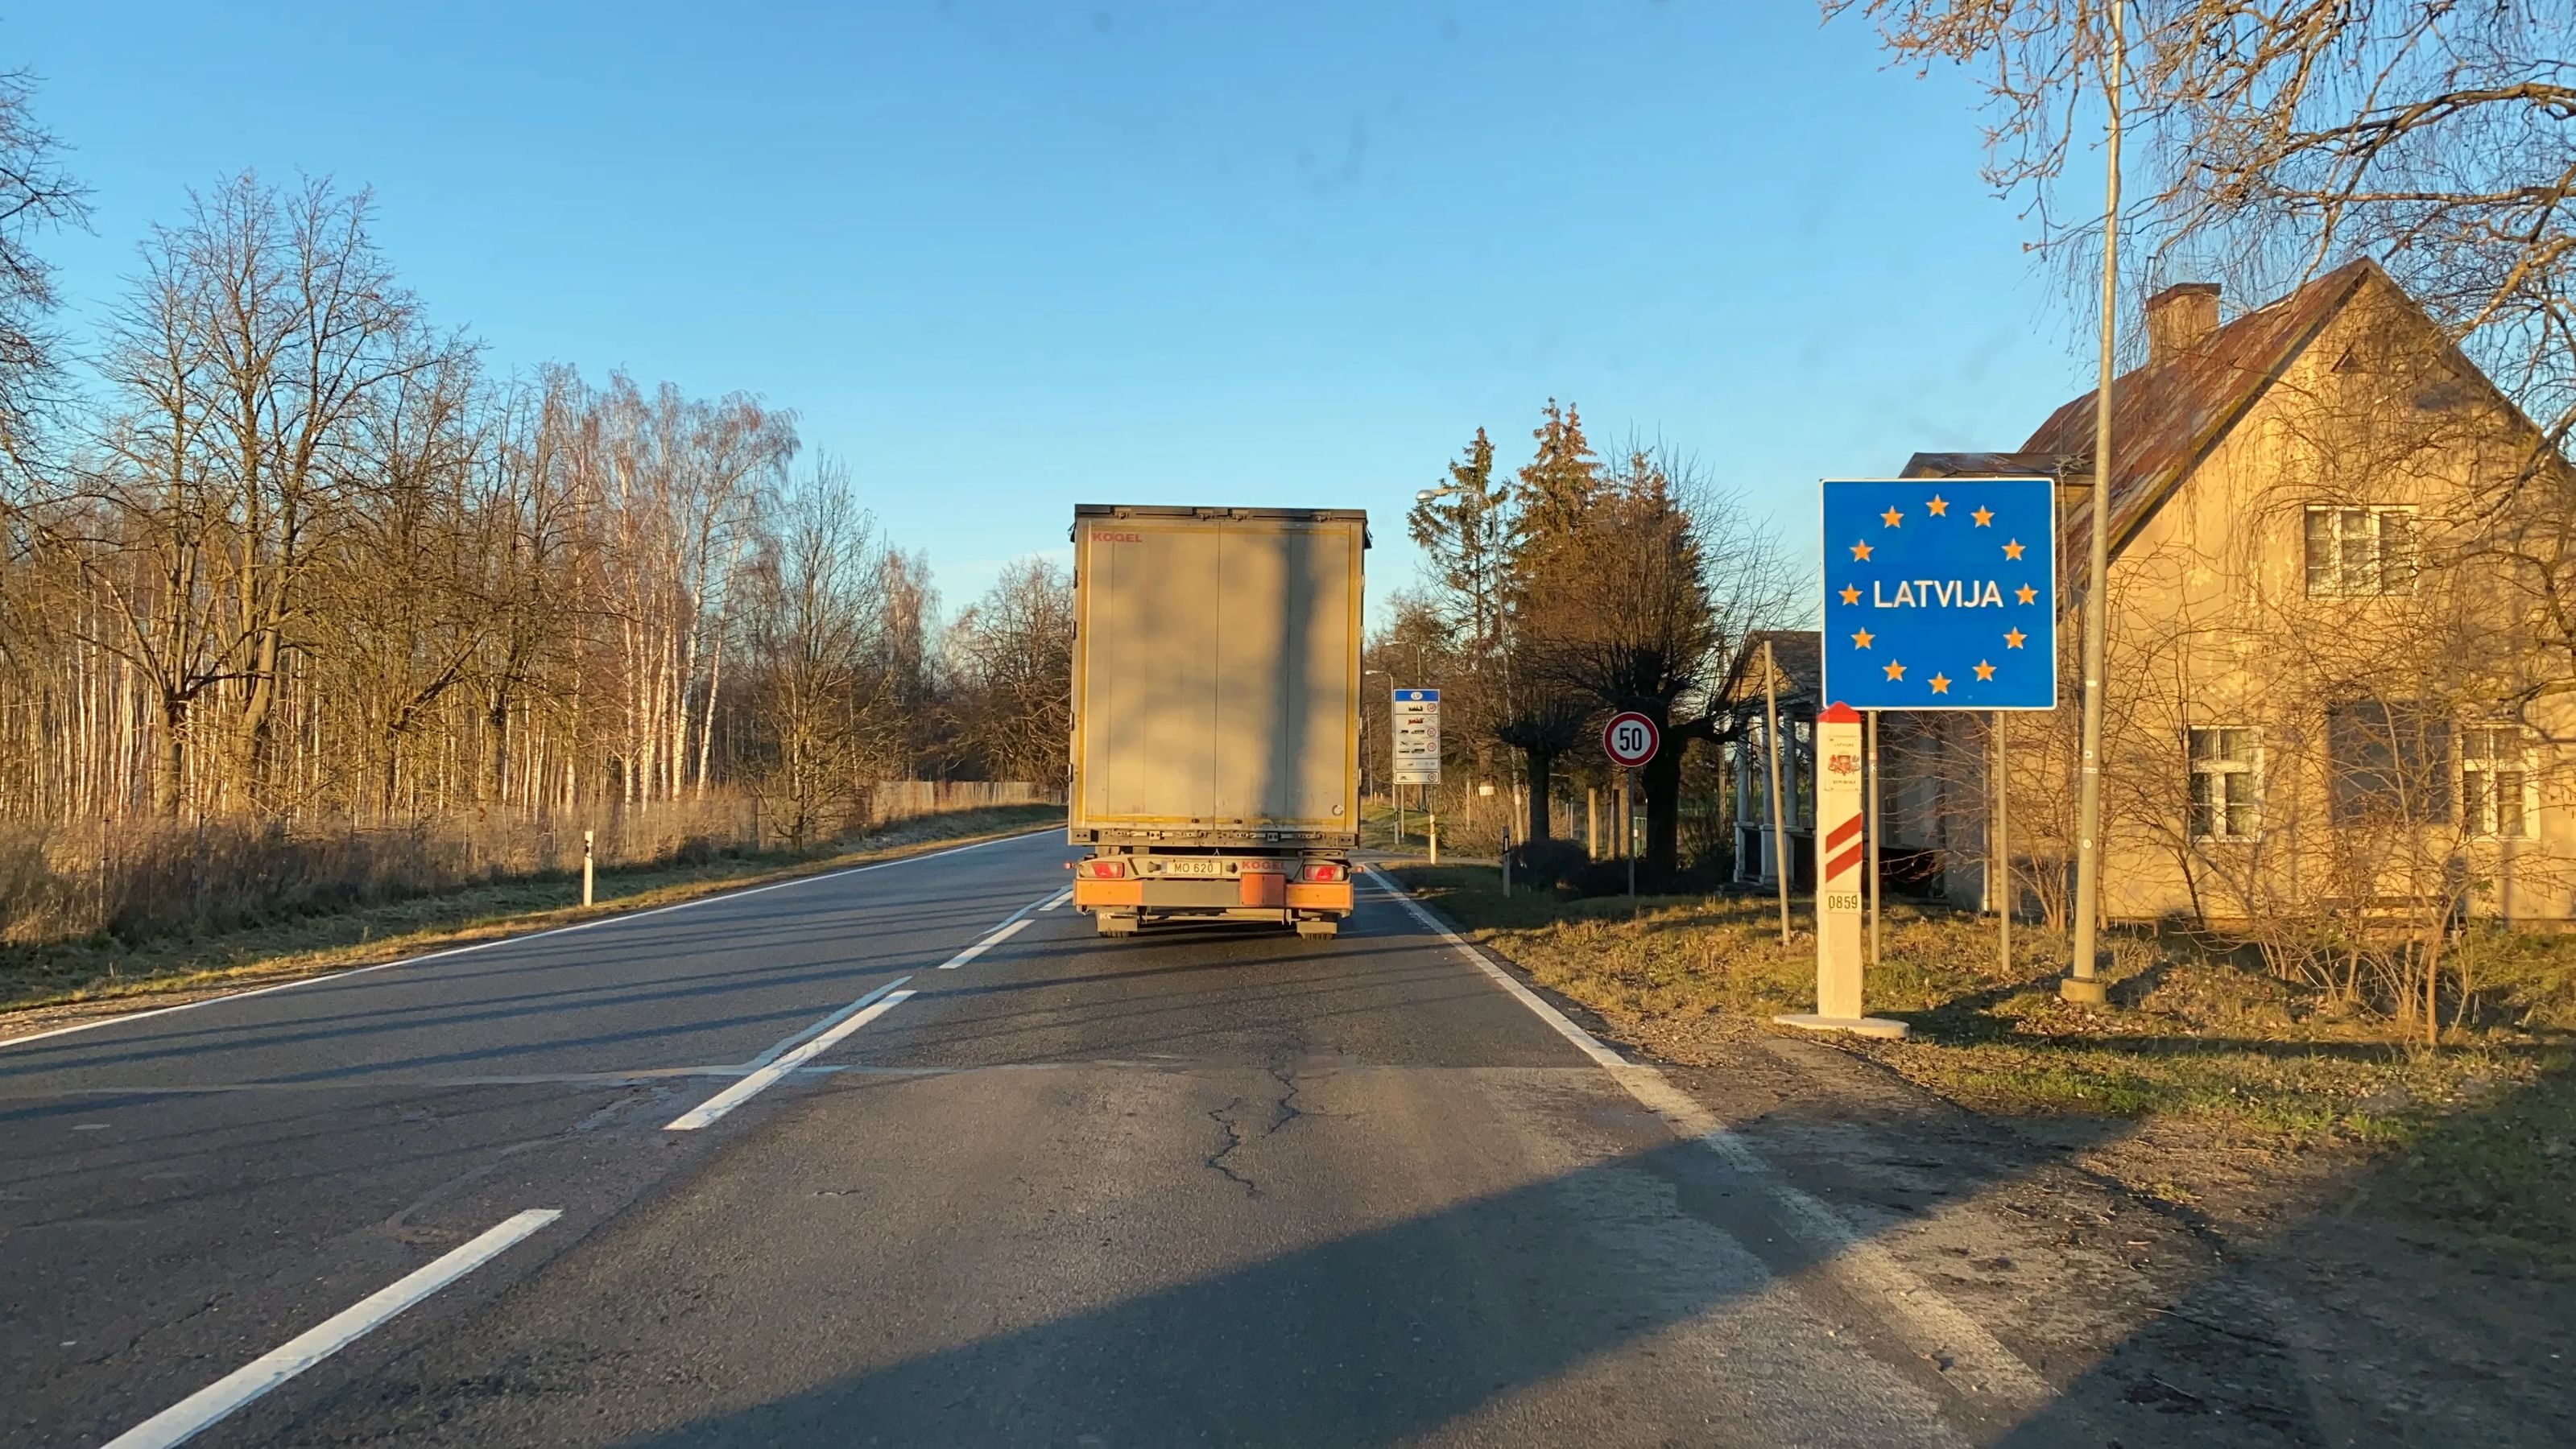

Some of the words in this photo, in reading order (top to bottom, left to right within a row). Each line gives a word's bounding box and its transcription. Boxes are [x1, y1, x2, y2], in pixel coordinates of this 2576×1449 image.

[1874, 580, 2004, 608] LATVIJA
[1619, 727, 1643, 751] 50
[1174, 863, 1189, 873] MO
[1193, 863, 1214, 873] 620
[1828, 895, 1858, 910] 0859
